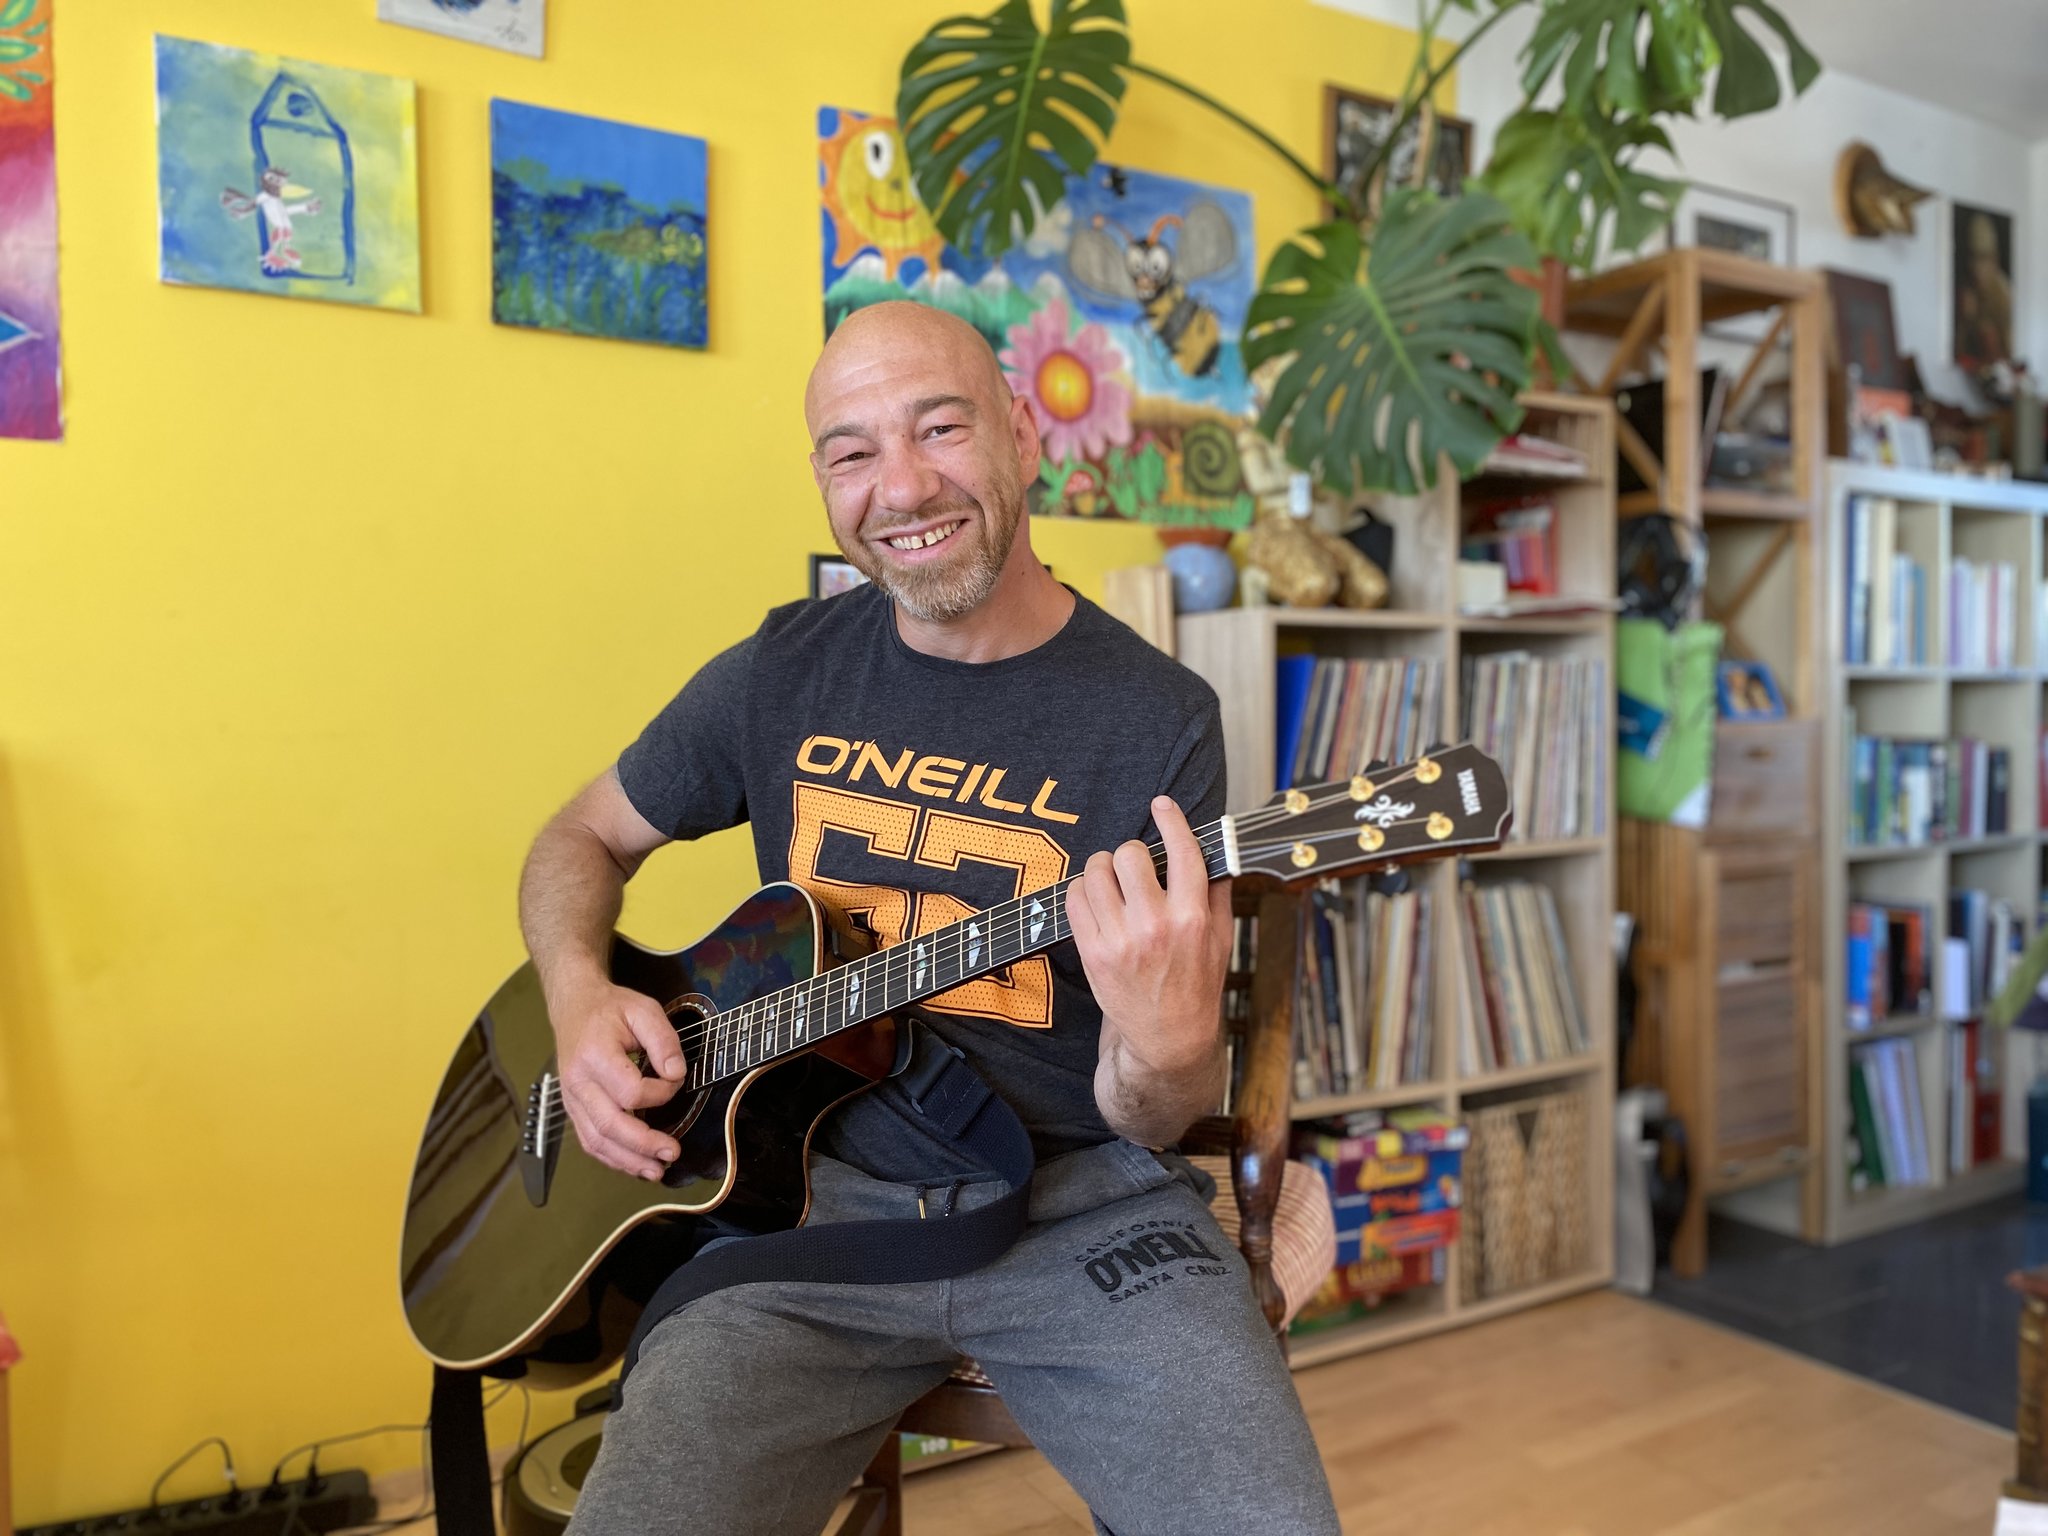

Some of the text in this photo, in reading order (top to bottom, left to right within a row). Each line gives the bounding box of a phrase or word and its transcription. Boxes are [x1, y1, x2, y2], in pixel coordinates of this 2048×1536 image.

[796, 735, 1080, 824] O'NEILL
[1457, 768, 1482, 816] YAMAHA
[1075, 1220, 1197, 1263] CALIFORNIA
[1109, 1265, 1232, 1304] SANTA CRUZ
